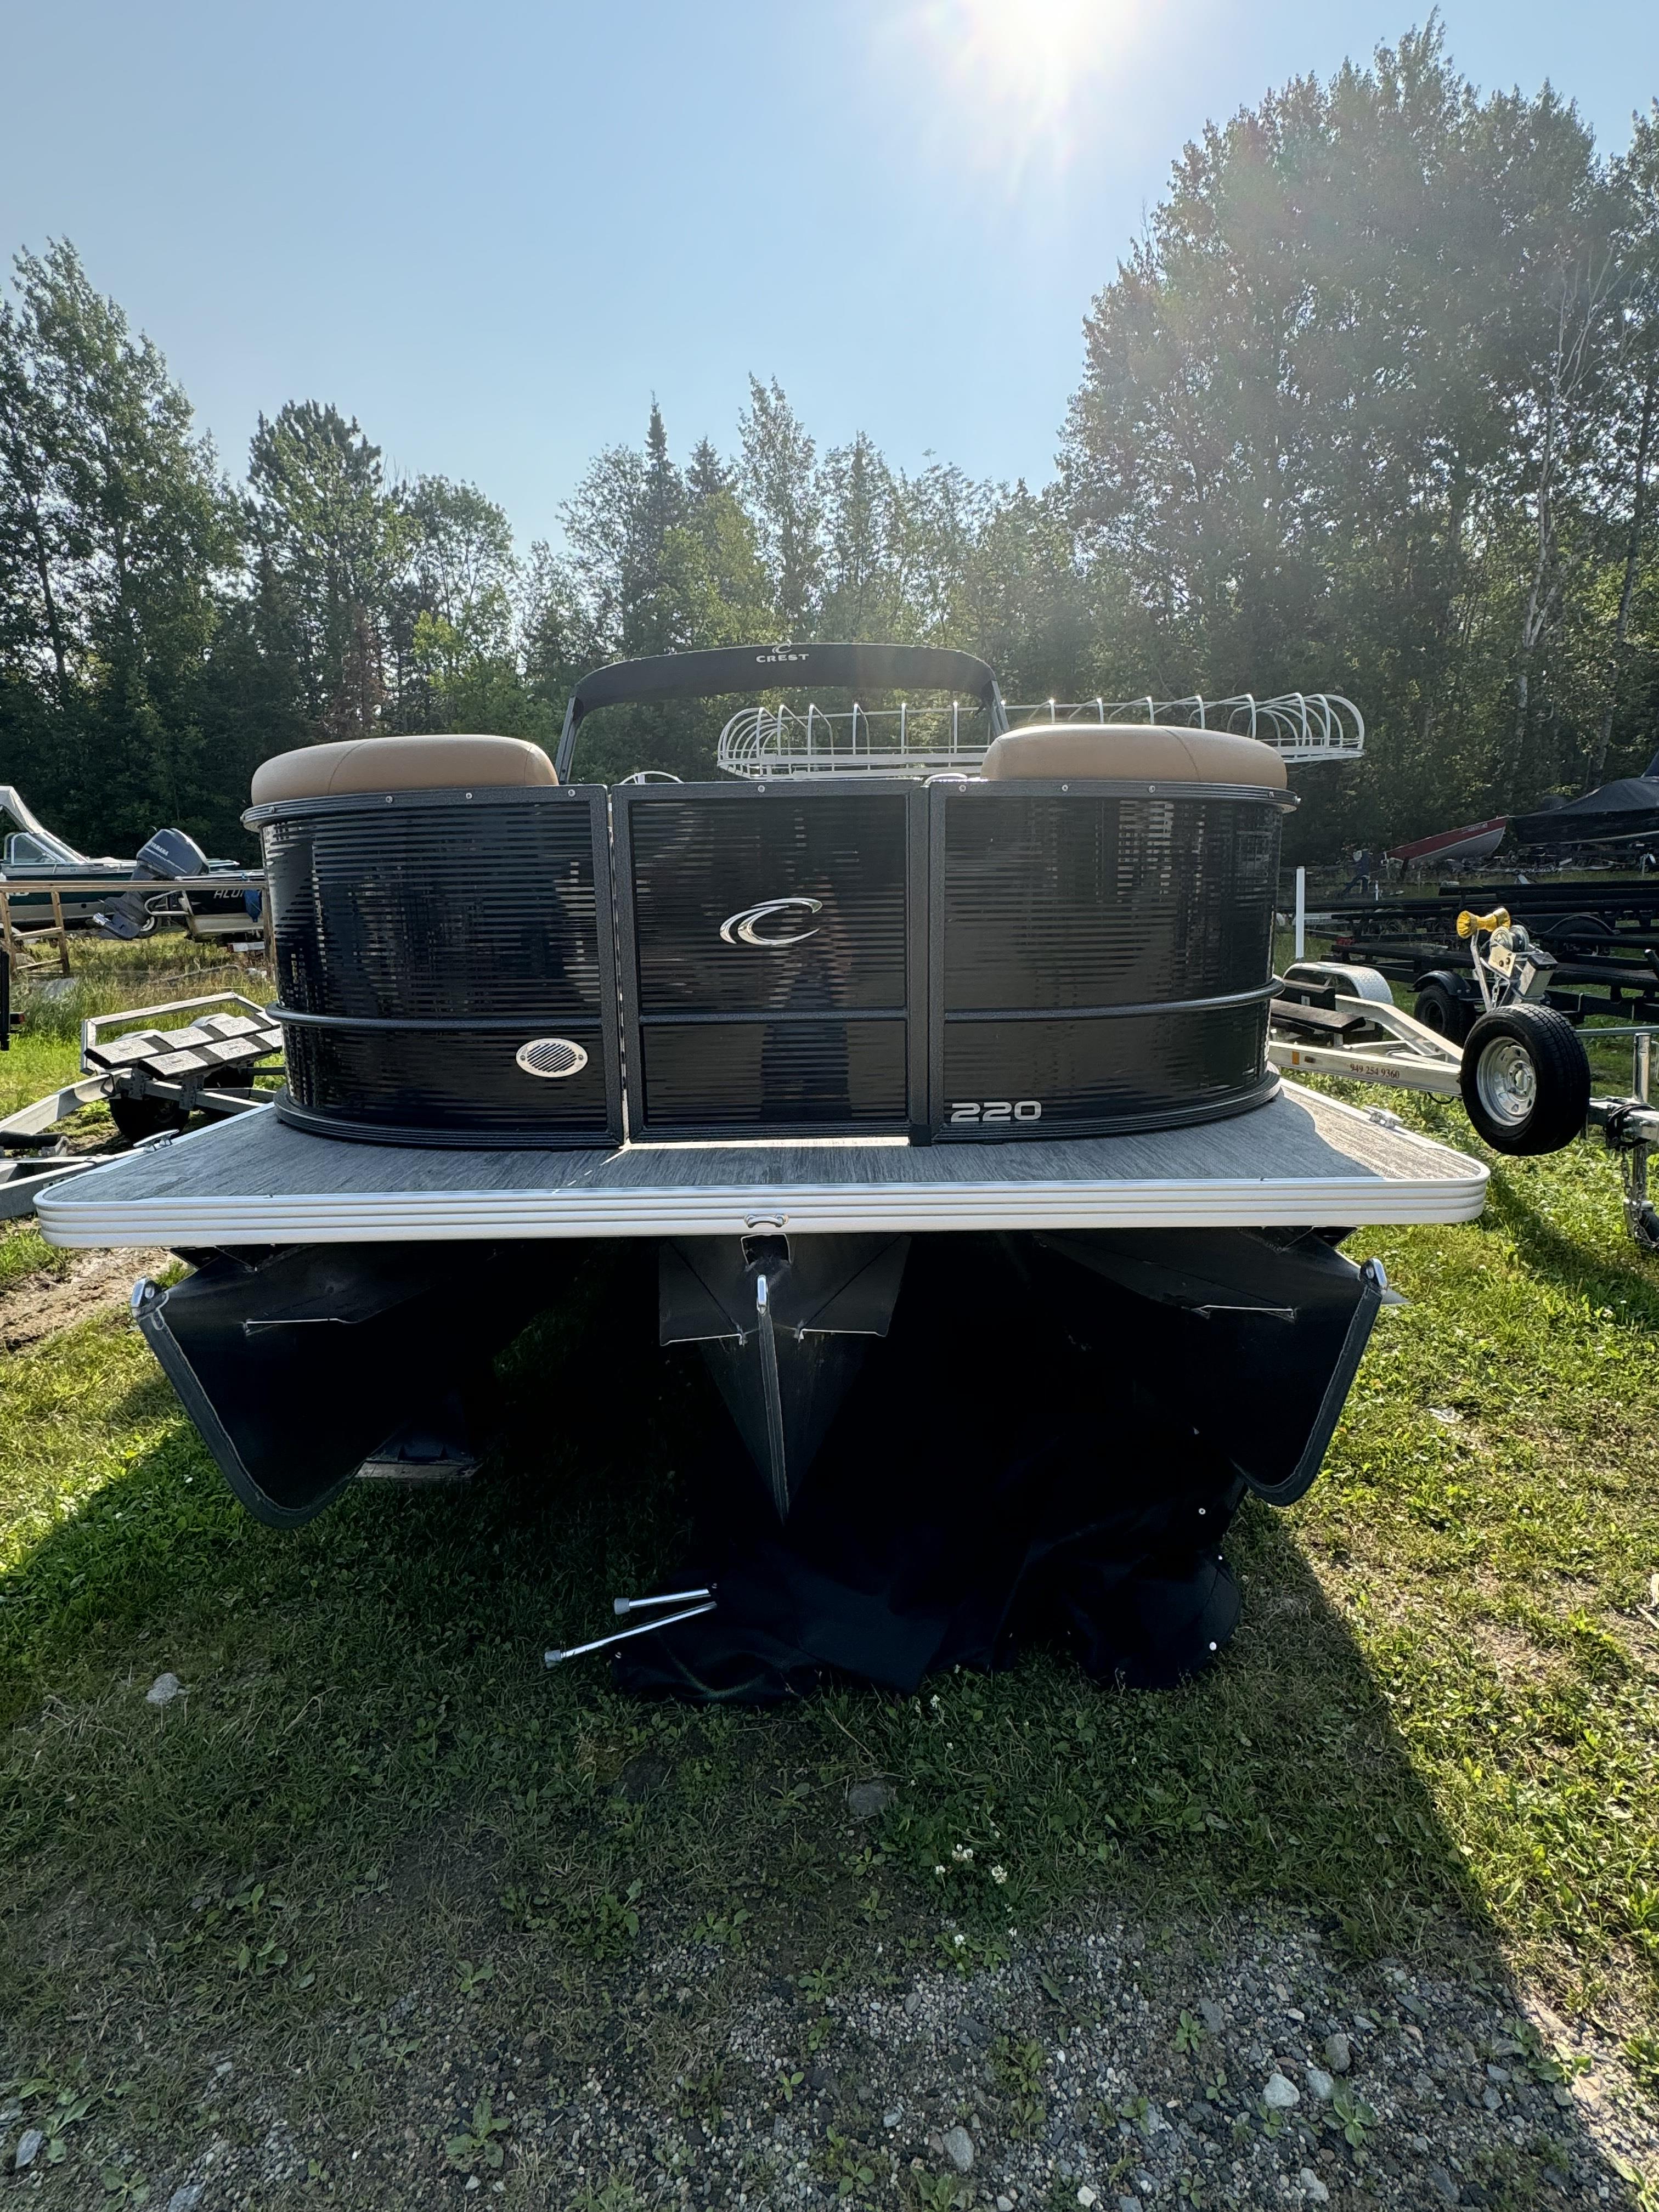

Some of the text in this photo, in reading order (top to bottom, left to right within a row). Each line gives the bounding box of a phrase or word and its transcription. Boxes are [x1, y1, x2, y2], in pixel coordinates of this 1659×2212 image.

[756, 653, 810, 663] CREST
[1350, 1063, 1400, 1079] 949 254 9360
[950, 1101, 1042, 1122] 220
